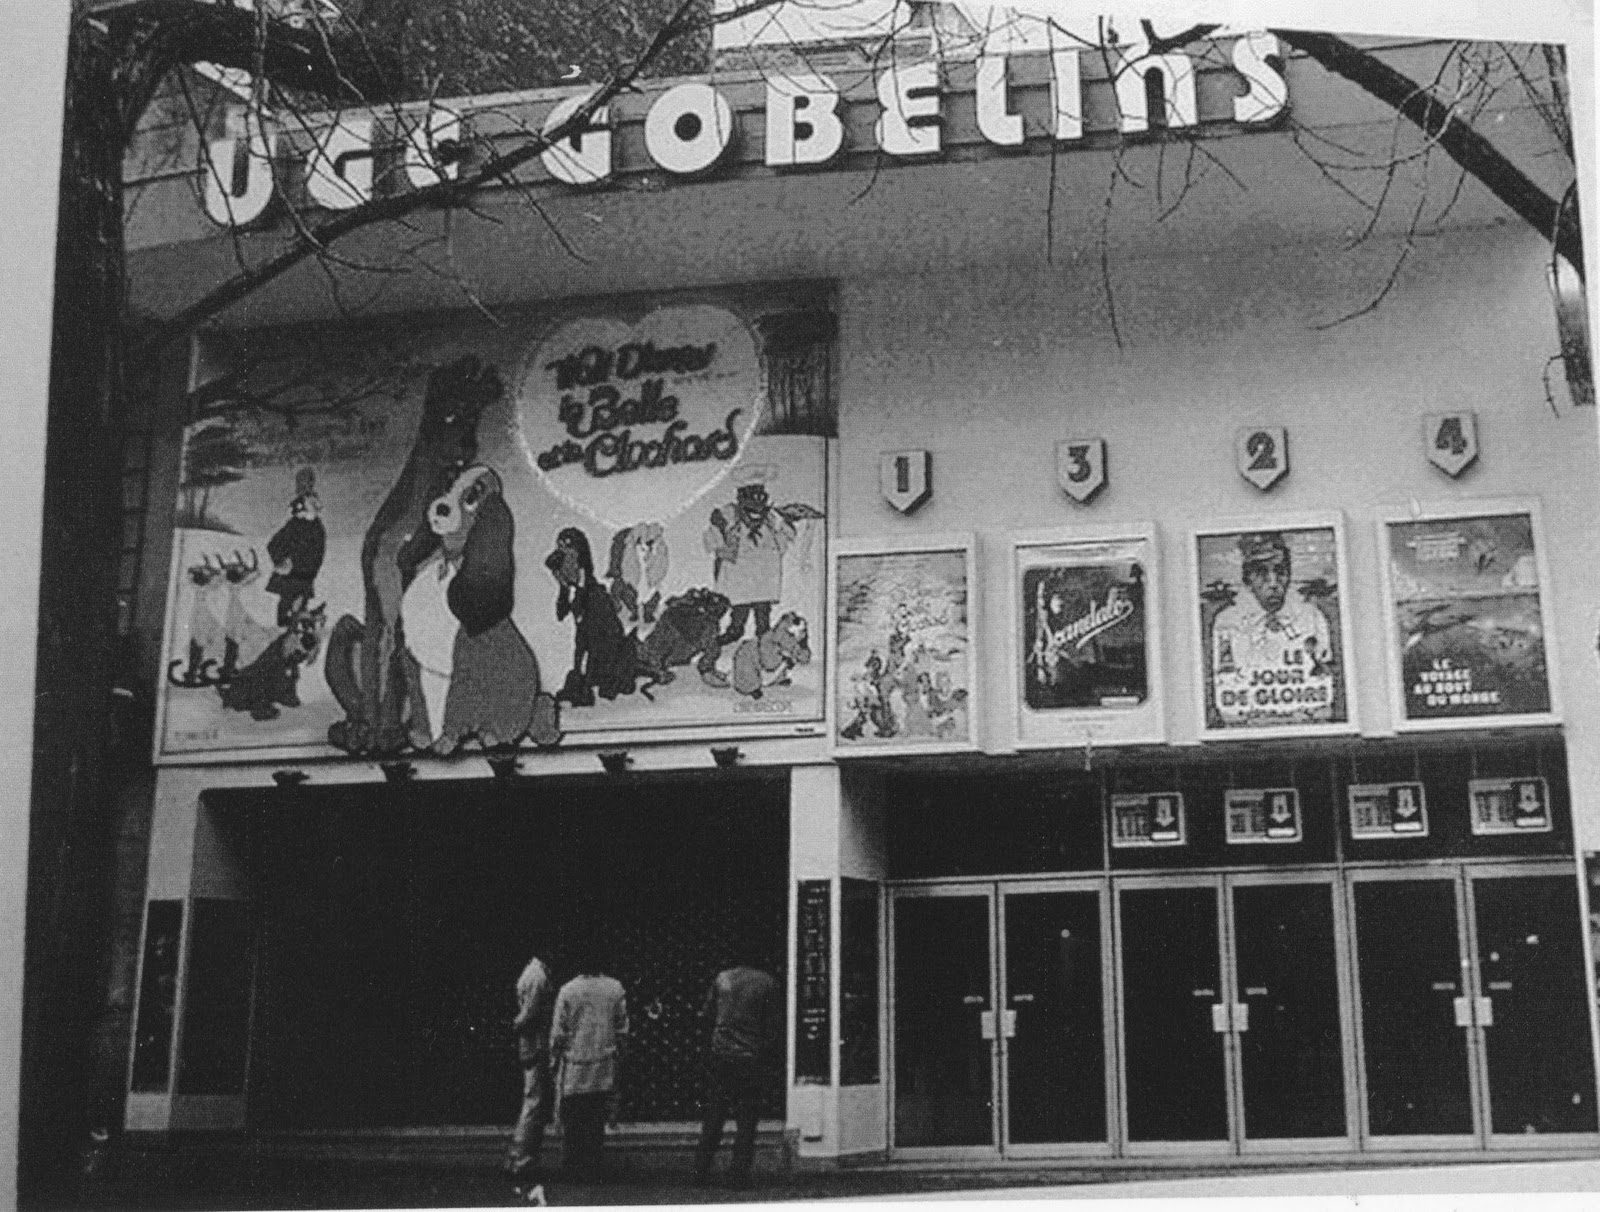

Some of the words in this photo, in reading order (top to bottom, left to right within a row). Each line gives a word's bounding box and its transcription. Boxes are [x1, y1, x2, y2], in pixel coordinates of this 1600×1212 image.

[1246, 431, 1278, 471] 2
[1434, 416, 1468, 455] 4
[894, 456, 910, 493] 1
[1067, 444, 1092, 483] 3
[1220, 689, 1249, 707] DE
[1255, 686, 1327, 706] GLOIRE
[1249, 668, 1305, 687] JOUR
